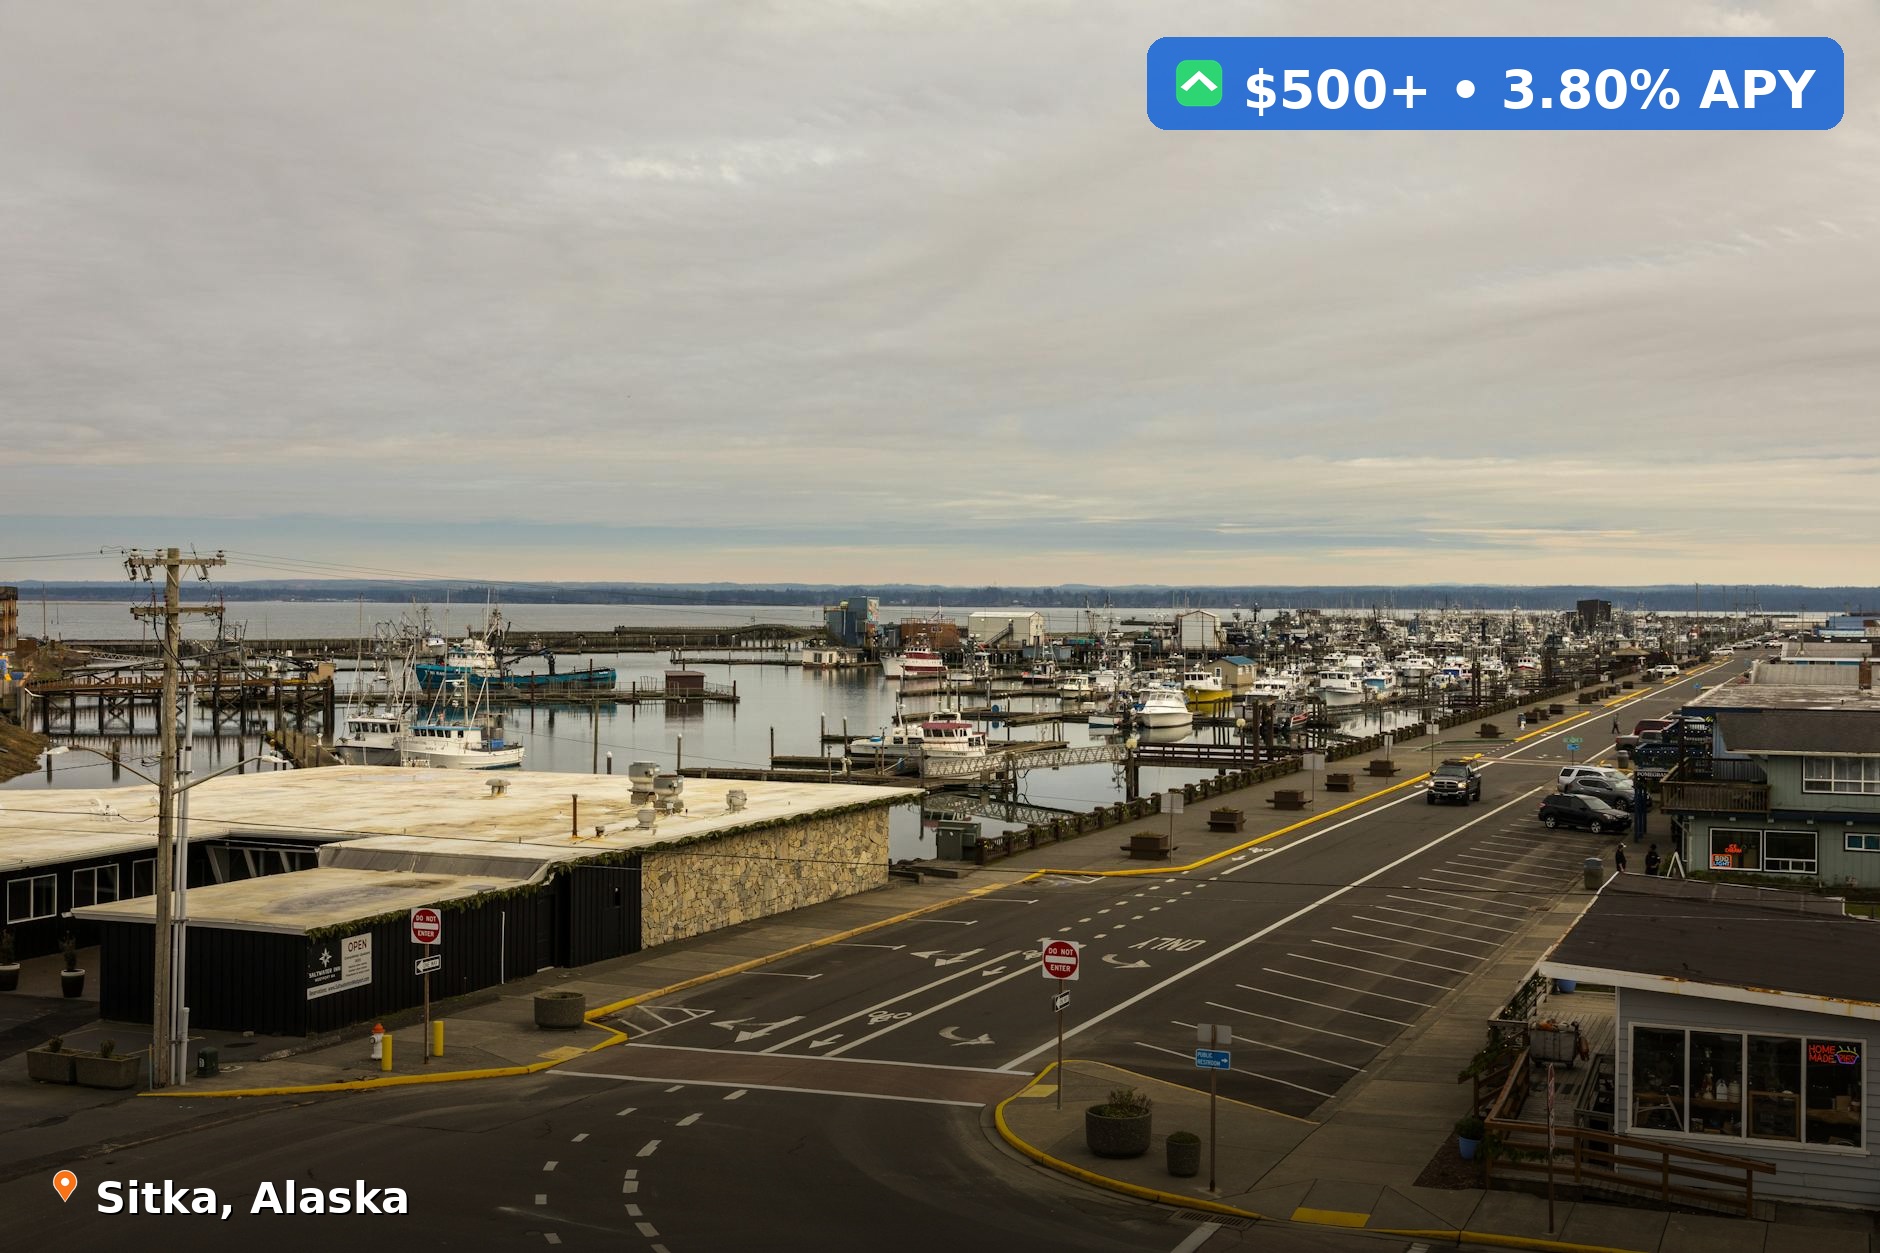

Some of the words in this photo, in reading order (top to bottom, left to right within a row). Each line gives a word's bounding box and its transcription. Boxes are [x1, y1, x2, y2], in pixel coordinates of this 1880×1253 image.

[348, 940, 367, 952] OPEN
[1127, 936, 1208, 951] ONLY
[1050, 964, 1071, 972] ENTER
[1809, 1044, 1836, 1055] HOME
[1197, 1059, 1220, 1067] RESTROOM
[1809, 1053, 1835, 1063] MADE
[1840, 1054, 1856, 1063] PIES
